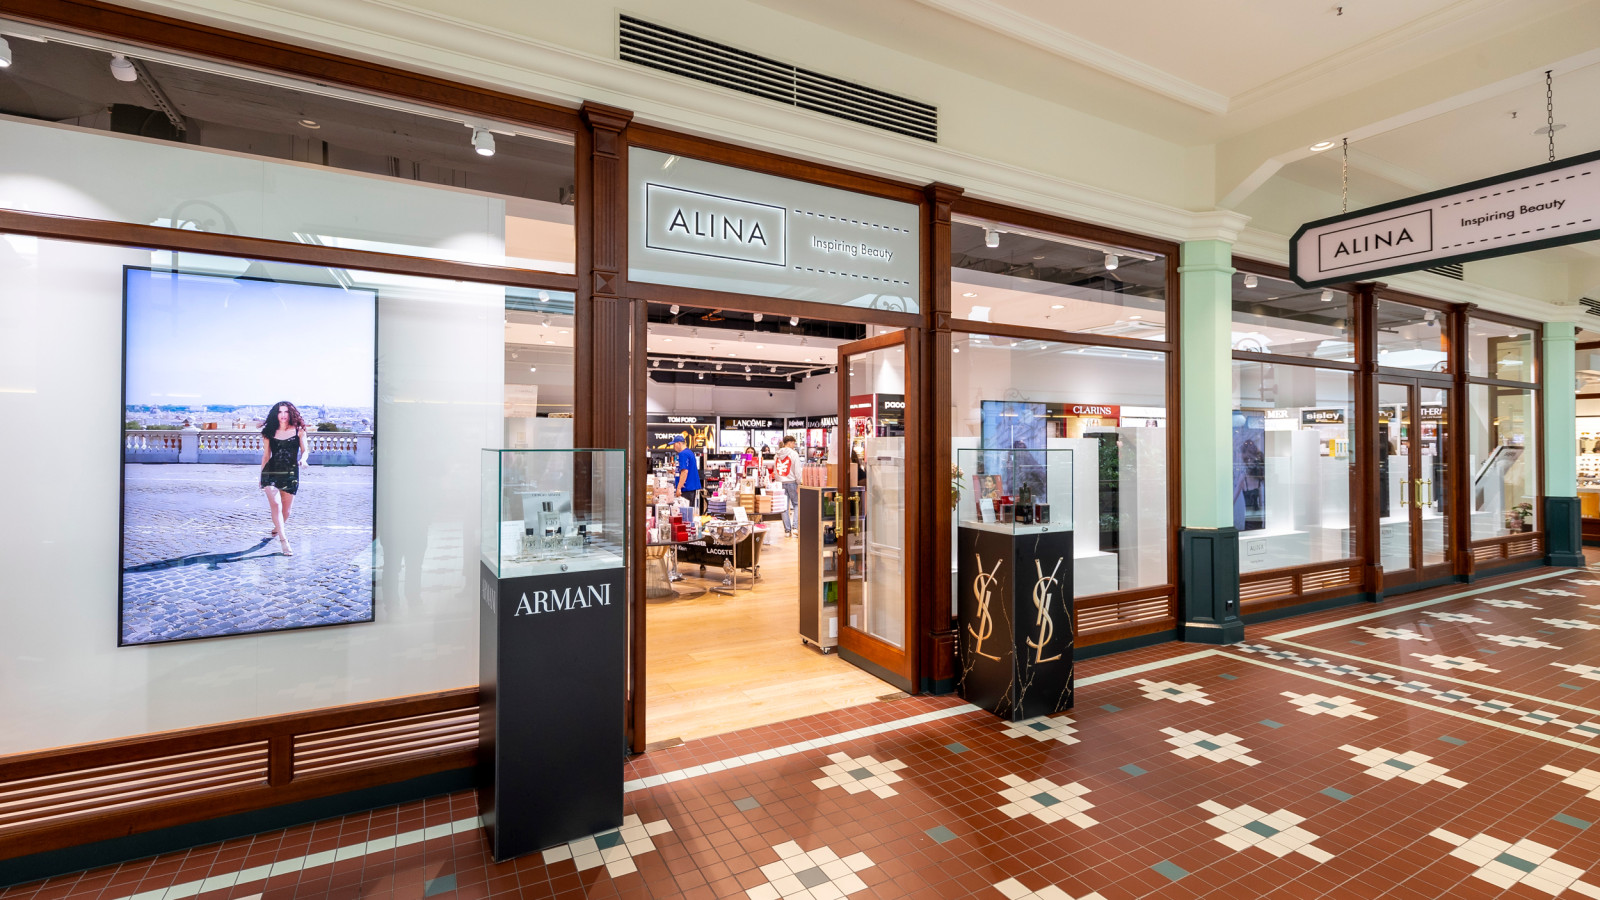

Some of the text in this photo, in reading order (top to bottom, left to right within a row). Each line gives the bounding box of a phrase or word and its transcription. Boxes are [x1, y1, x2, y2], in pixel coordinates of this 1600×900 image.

[1460, 198, 1566, 227] Inspiring Beauty
[669, 208, 767, 246] ALINA
[1334, 227, 1414, 258] ALINA
[811, 235, 893, 262] Inspiring Beauty
[1072, 405, 1112, 415] CLARINS
[681, 416, 697, 424] FORD
[820, 416, 839, 427] ARMAN
[1306, 412, 1340, 420] sisley
[732, 418, 766, 428] LANCÔME
[706, 548, 733, 556] LACOSTE
[514, 583, 611, 616] ARMANI
